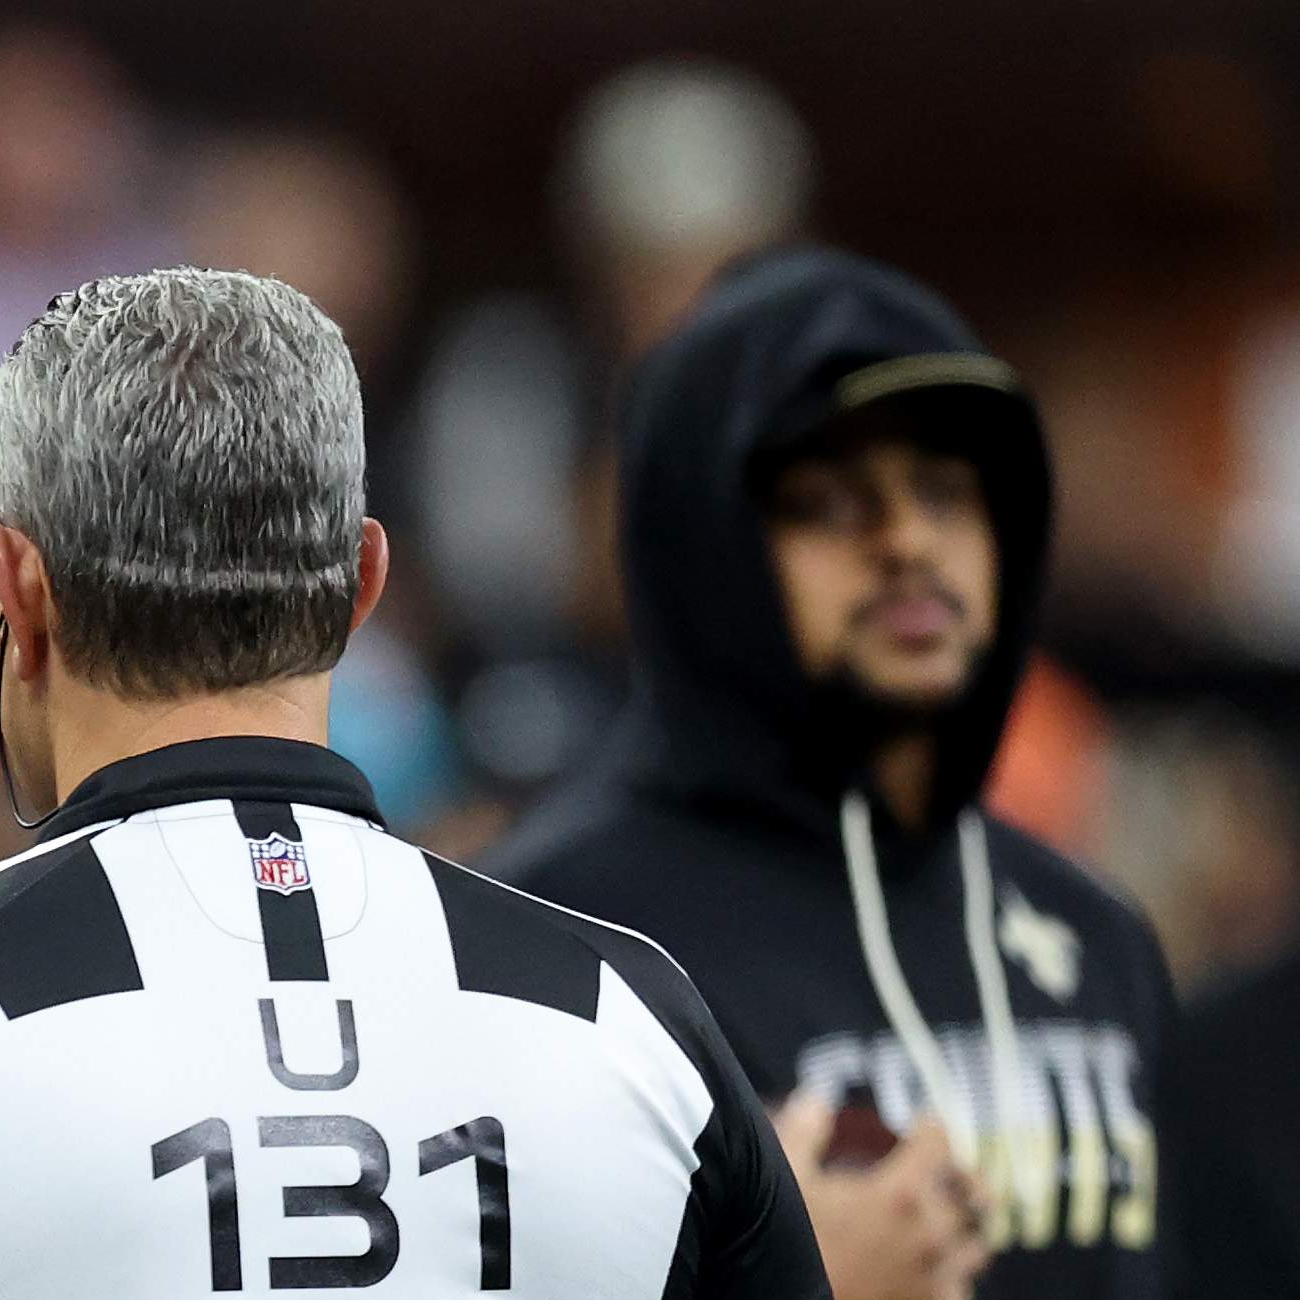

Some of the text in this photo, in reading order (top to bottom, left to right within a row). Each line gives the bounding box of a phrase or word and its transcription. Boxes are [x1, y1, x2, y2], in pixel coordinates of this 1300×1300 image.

[256, 860, 305, 886] NFL
[257, 998, 361, 1092] U
[151, 1116, 513, 1292] 131
